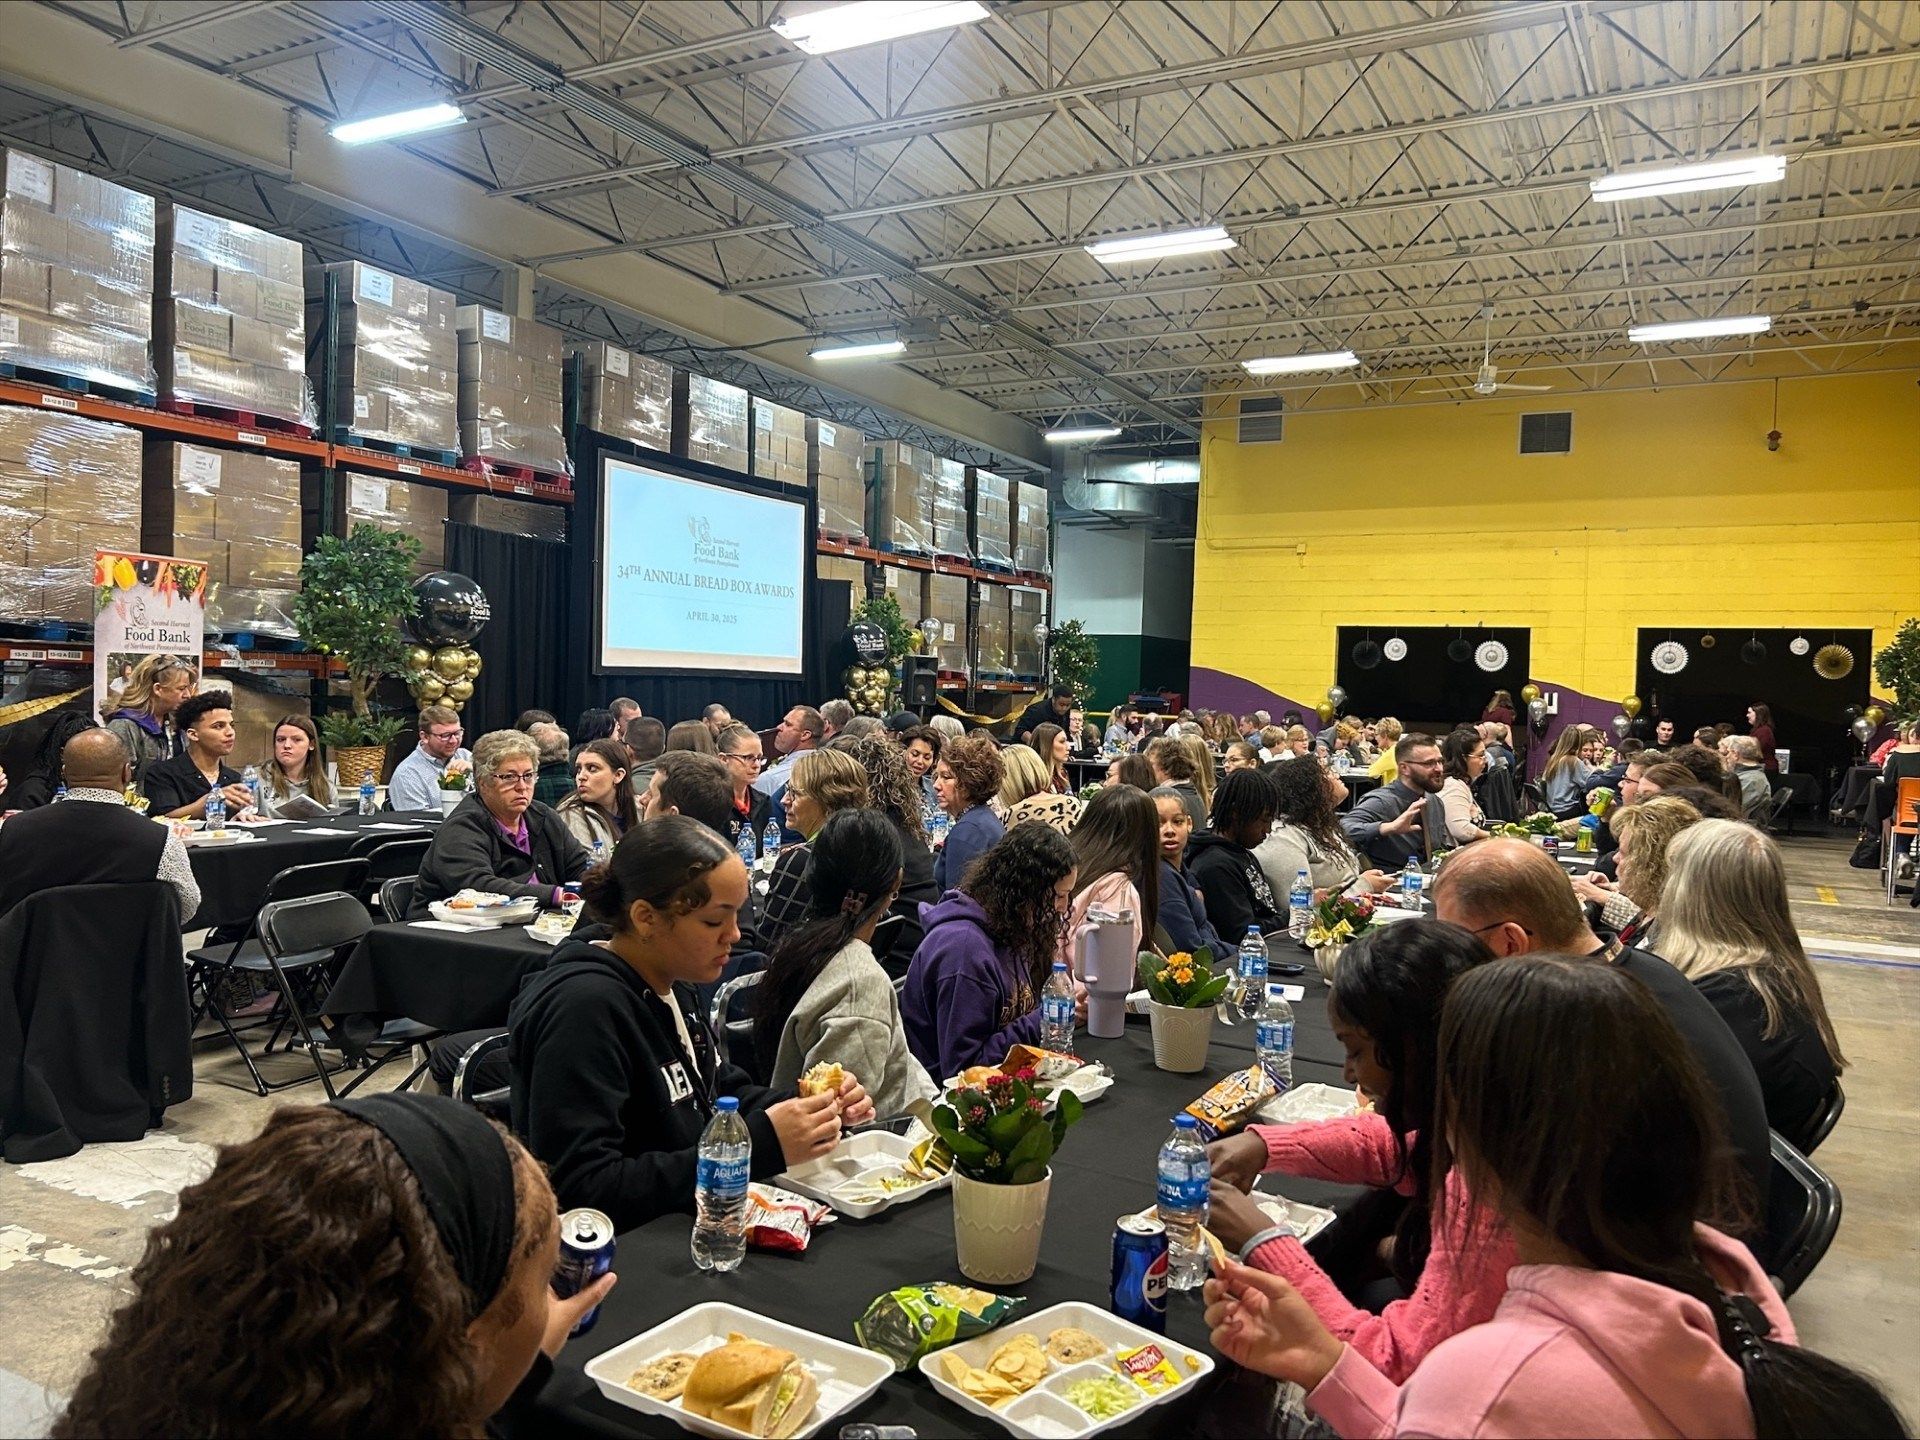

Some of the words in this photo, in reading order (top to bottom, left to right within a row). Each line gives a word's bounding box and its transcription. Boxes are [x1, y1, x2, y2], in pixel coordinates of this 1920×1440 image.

[184, 321, 205, 333] Food
[694, 542, 716, 557] Food
[718, 546, 740, 560] Bank
[617, 565, 641, 579] 34TH
[643, 568, 691, 587] ANNUAL
[694, 574, 729, 592] BREAD
[730, 580, 753, 595] BOX
[754, 583, 795, 598] AWARDS
[470, 606, 485, 615] Food
[686, 610, 709, 622] APRIL
[711, 612, 722, 624] 30,
[722, 613, 738, 625] 2025
[124, 627, 154, 641] Food
[159, 628, 190, 643] Bank
[124, 642, 130, 650] of
[131, 643, 155, 651] Northwest
